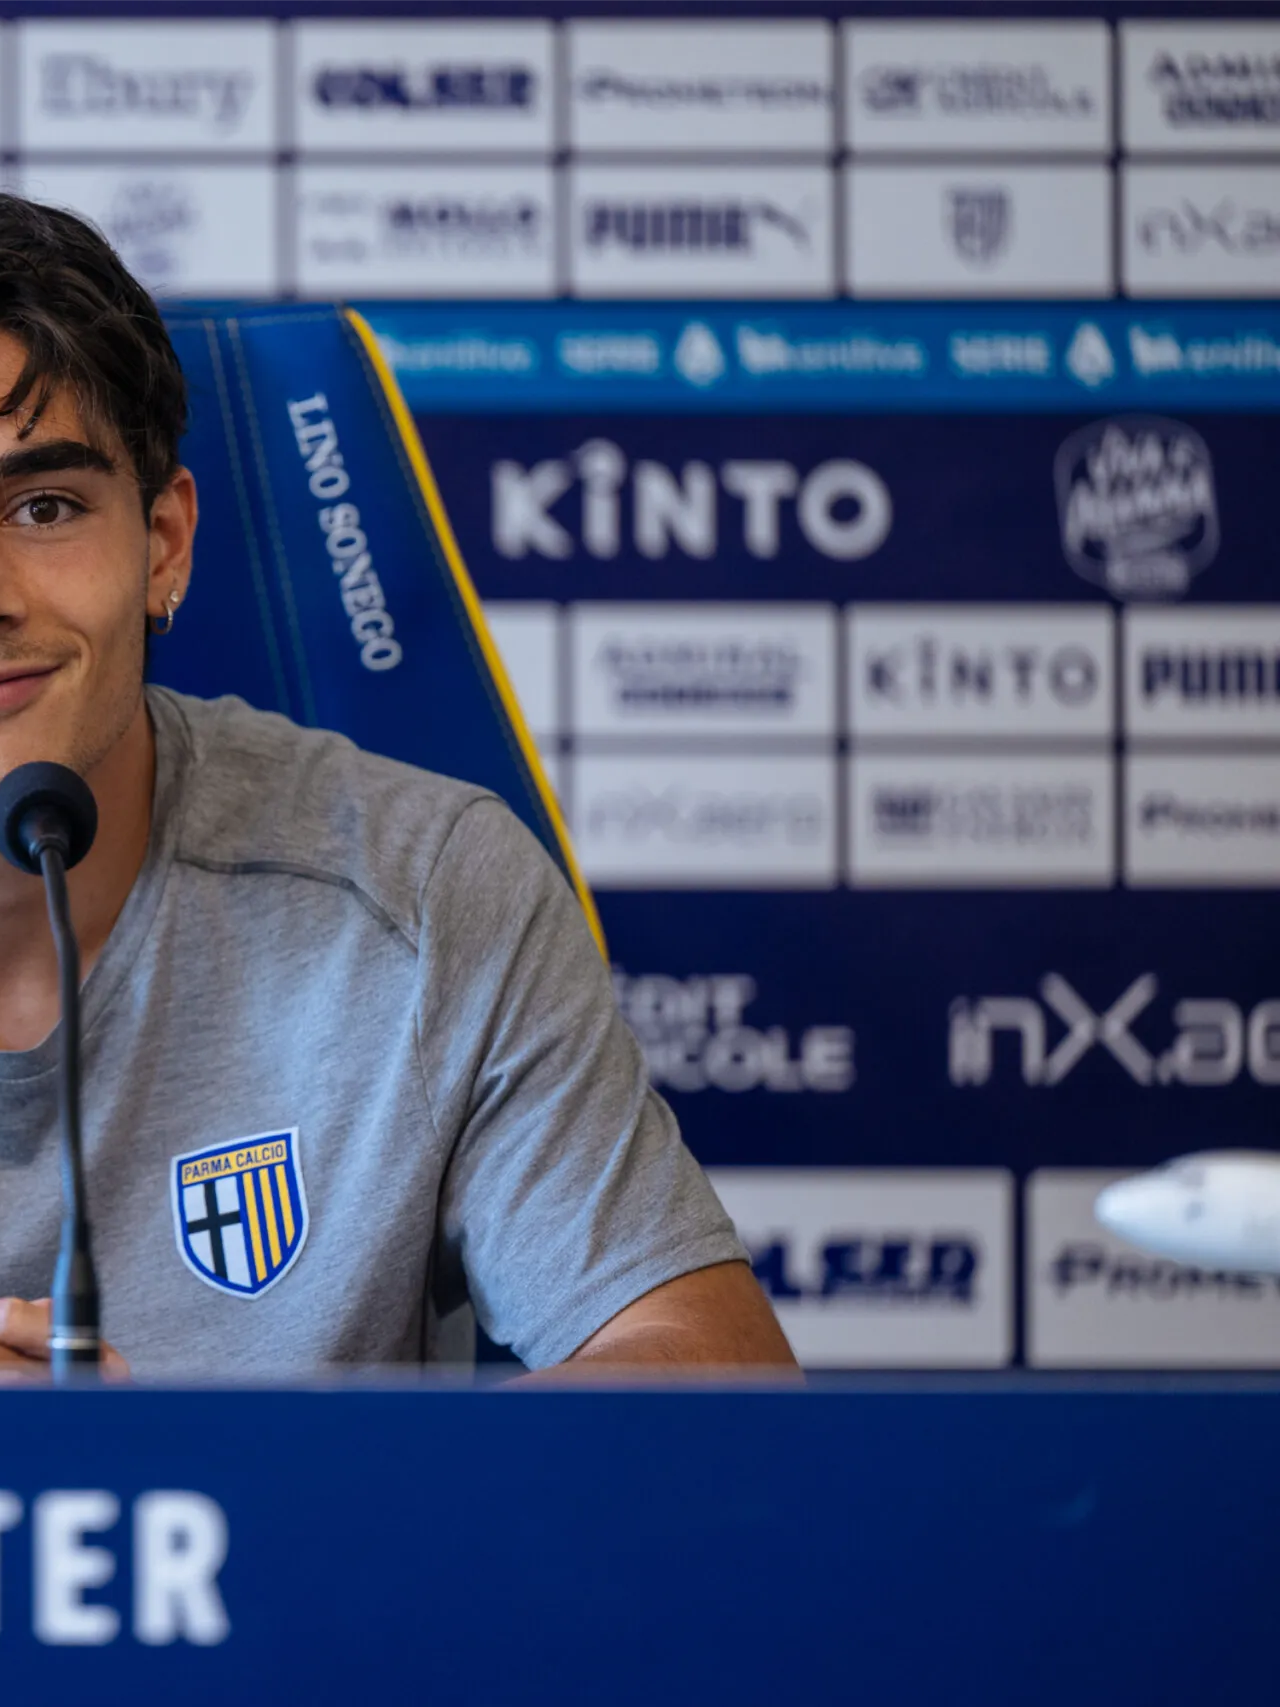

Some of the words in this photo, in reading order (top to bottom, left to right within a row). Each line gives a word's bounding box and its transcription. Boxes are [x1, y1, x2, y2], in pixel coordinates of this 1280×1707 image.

[286, 392, 351, 500] LINO
[489, 436, 894, 562] KINTO
[318, 502, 404, 672] SONEGO
[184, 1156, 233, 1181] PARMA
[235, 1143, 285, 1169] CALCIO
